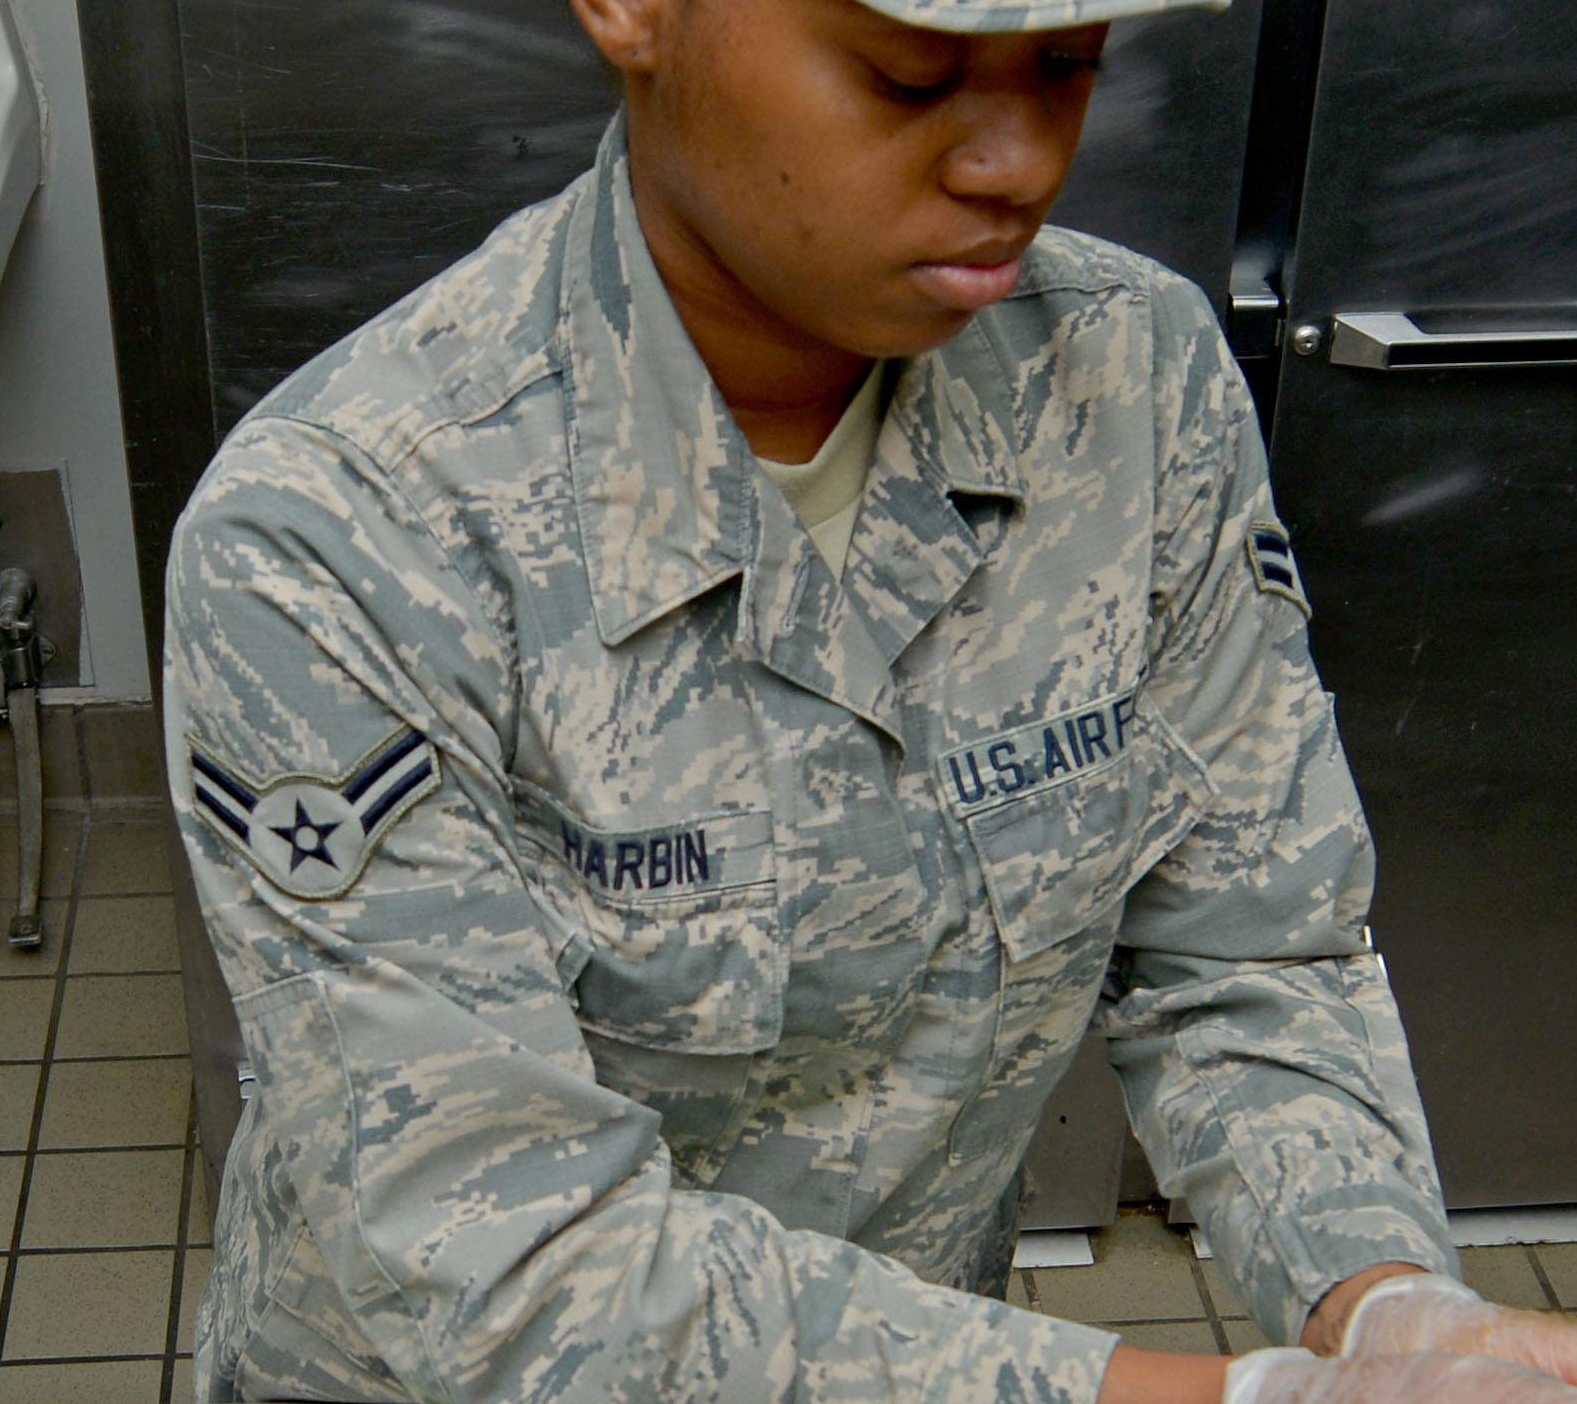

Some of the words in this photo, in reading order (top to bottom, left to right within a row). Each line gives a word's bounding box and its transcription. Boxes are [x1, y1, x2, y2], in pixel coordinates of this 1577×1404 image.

[949, 741, 1036, 804] U.S.
[1043, 711, 1112, 779] AIR
[560, 819, 709, 891] HARBIN
